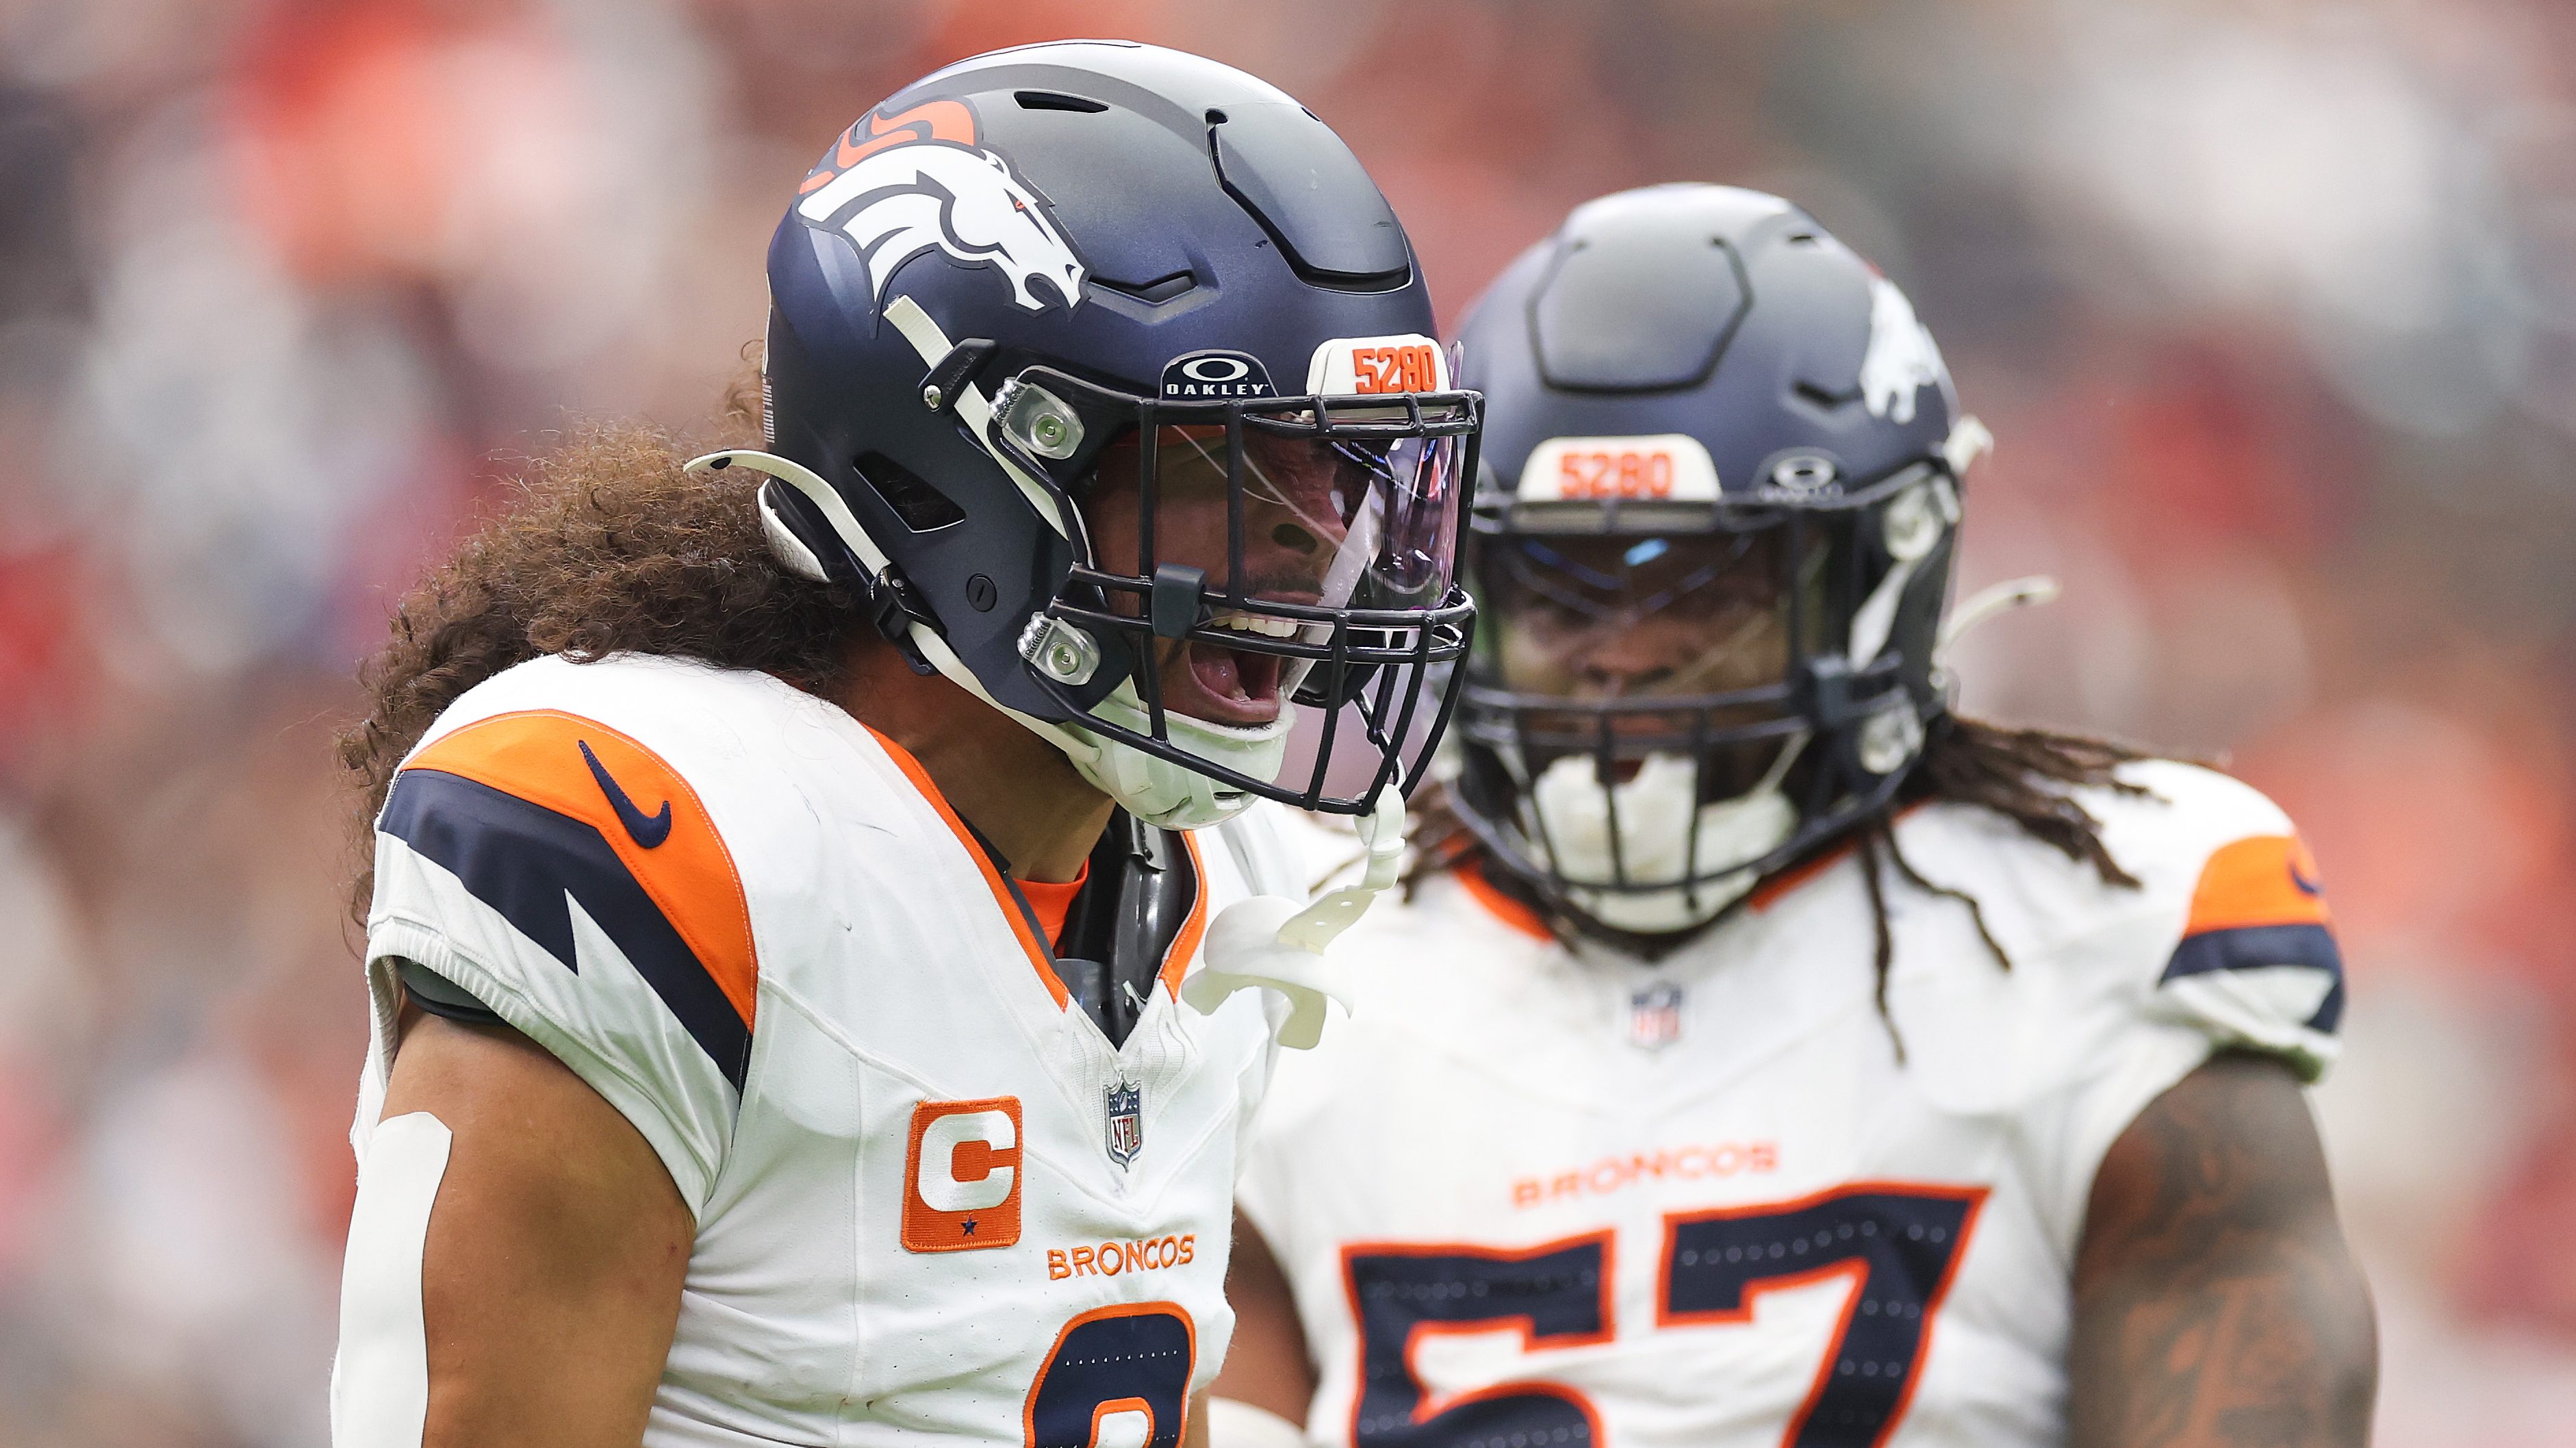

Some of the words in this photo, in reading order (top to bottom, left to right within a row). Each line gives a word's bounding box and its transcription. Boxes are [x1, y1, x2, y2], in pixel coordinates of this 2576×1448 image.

[1166, 383, 1265, 395] OAKLEY
[1351, 344, 1437, 394] 5280
[1561, 453, 1672, 499] 5280
[1111, 1117, 1139, 1153] NFL
[918, 1109, 1016, 1212] C
[1511, 1141, 1780, 1210] BRONCOS
[1047, 1233, 1196, 1281] BRONCOS
[1339, 1179, 1993, 1448] 57
